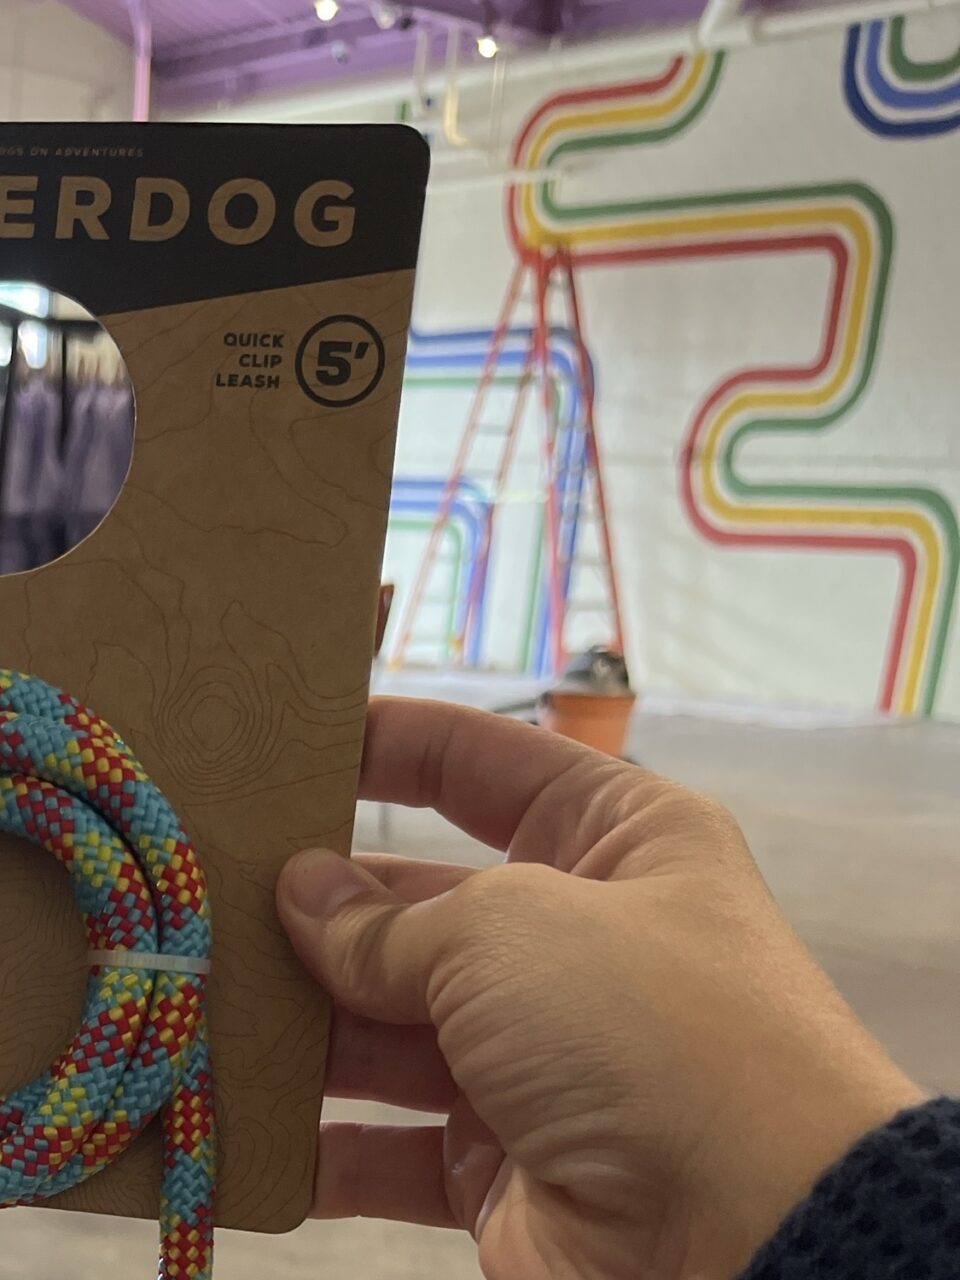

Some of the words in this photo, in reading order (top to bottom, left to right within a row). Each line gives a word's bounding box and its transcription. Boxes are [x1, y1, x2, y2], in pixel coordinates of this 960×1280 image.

[30, 147, 49, 157] ON
[55, 147, 145, 158] ADVENTURES
[223, 332, 285, 349] QUICK
[239, 353, 282, 369] CLIP
[315, 340, 370, 386] 5'
[215, 373, 280, 389] LEASH
